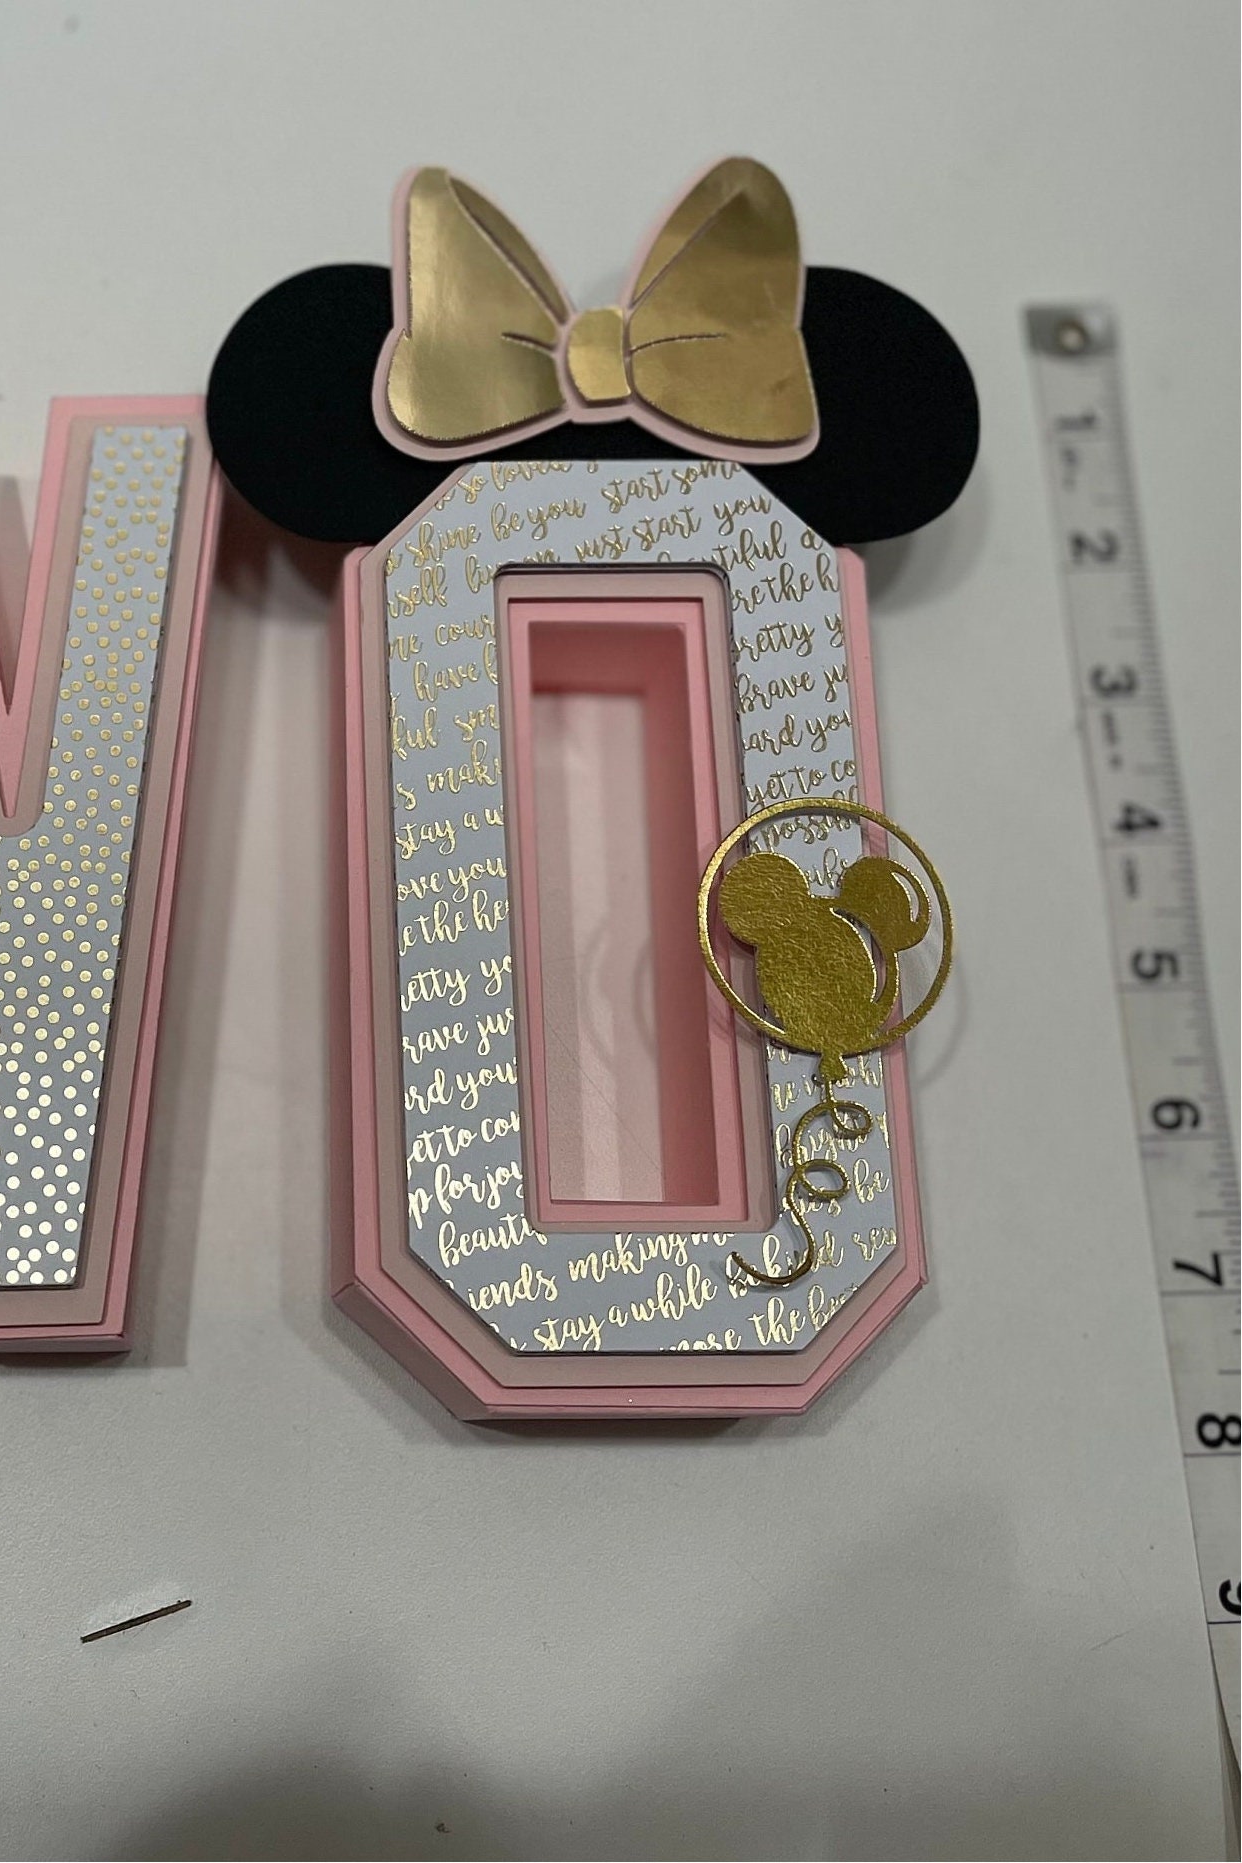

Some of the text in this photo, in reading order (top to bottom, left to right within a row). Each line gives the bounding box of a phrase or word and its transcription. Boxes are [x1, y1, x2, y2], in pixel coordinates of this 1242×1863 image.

[491, 502, 524, 541] be
[601, 467, 670, 514] start
[633, 505, 701, 551] start
[713, 495, 772, 537] you
[760, 562, 814, 603] the
[413, 661, 481, 702] have
[736, 672, 815, 714] brave
[743, 713, 803, 756] ard
[788, 765, 828, 795] to
[463, 811, 480, 831] a
[414, 900, 469, 945] the
[1052, 409, 1240, 1449] 1 2 3 4 5 6 7 8
[435, 1124, 478, 1157] to
[439, 1213, 548, 1268] beauti
[568, 1232, 688, 1283] making
[608, 1304, 628, 1328] a
[630, 1263, 718, 1321] while
[747, 1296, 806, 1346] the
